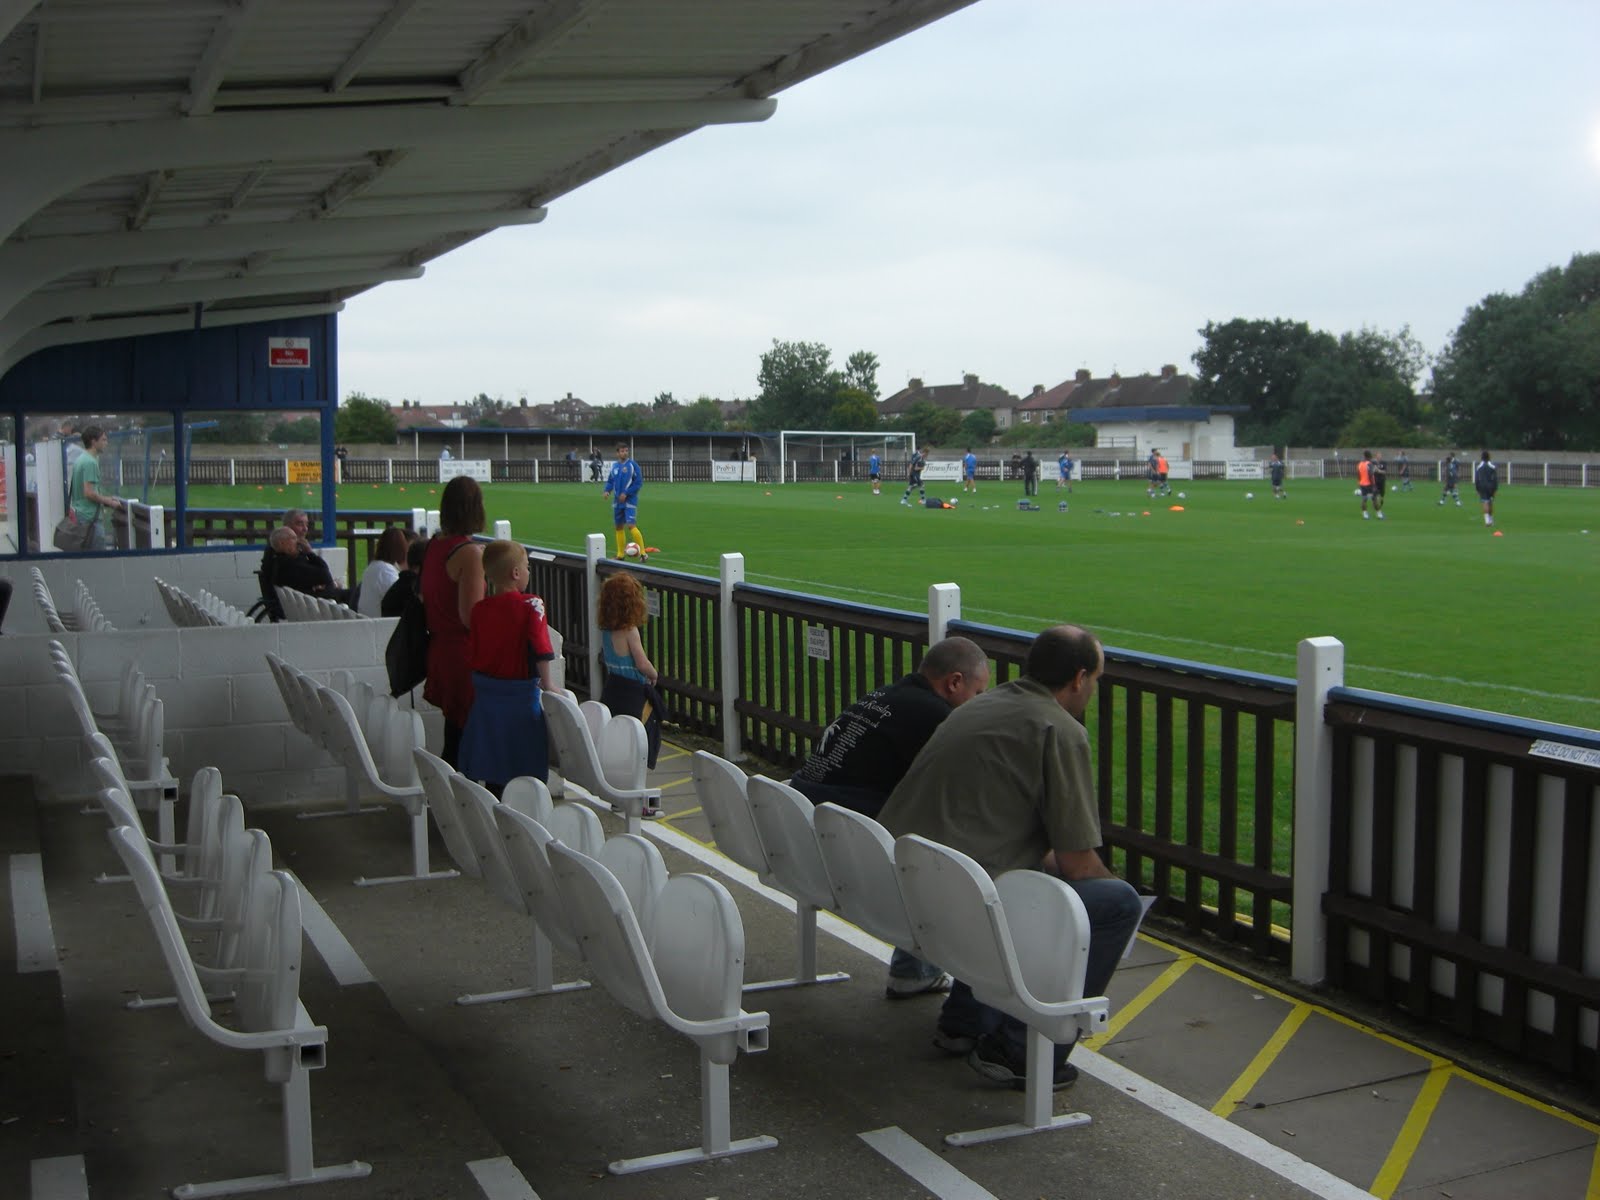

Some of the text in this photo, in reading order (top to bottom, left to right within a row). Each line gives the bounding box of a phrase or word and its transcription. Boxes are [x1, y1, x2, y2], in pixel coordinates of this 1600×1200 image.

[1535, 742, 1560, 756] PLEASE
[1558, 746, 1569, 758] DO
[1568, 748, 1584, 760] NOT
